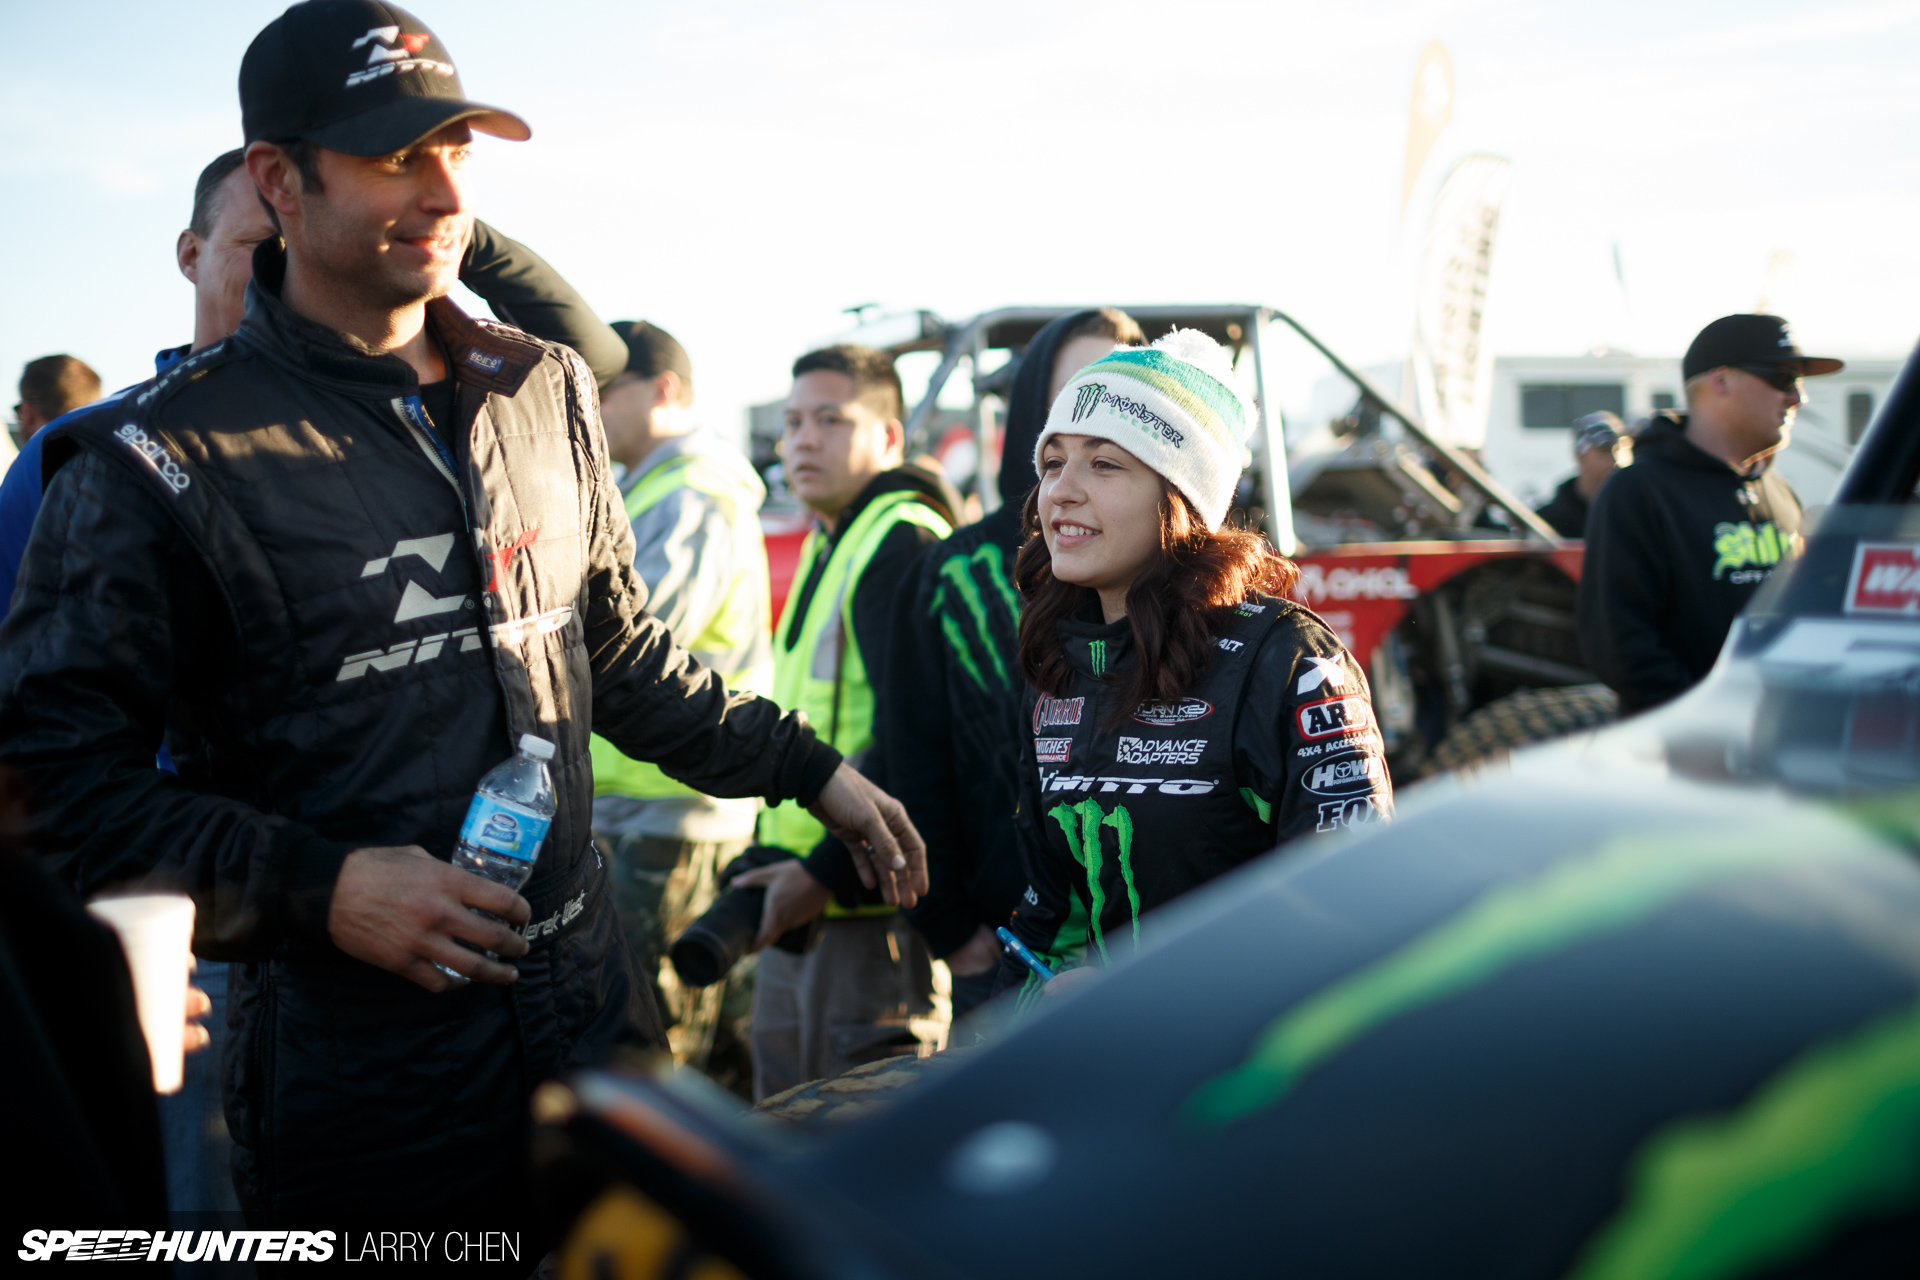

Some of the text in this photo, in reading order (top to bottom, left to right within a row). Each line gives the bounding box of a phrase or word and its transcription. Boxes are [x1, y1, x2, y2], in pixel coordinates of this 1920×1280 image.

[346, 58, 454, 87] NITTO
[1102, 392, 1184, 449] MONSTER
[113, 424, 191, 494] sparco
[336, 601, 576, 682] NITTO
[1033, 691, 1085, 735] CURRIE
[1177, 702, 1208, 715] KEY
[1307, 701, 1365, 734] ARB
[1036, 740, 1071, 754] HUGHES
[1119, 751, 1201, 764] ADAPTERS
[1130, 738, 1208, 752] ADVANCE
[1049, 775, 1215, 795] NITTO
